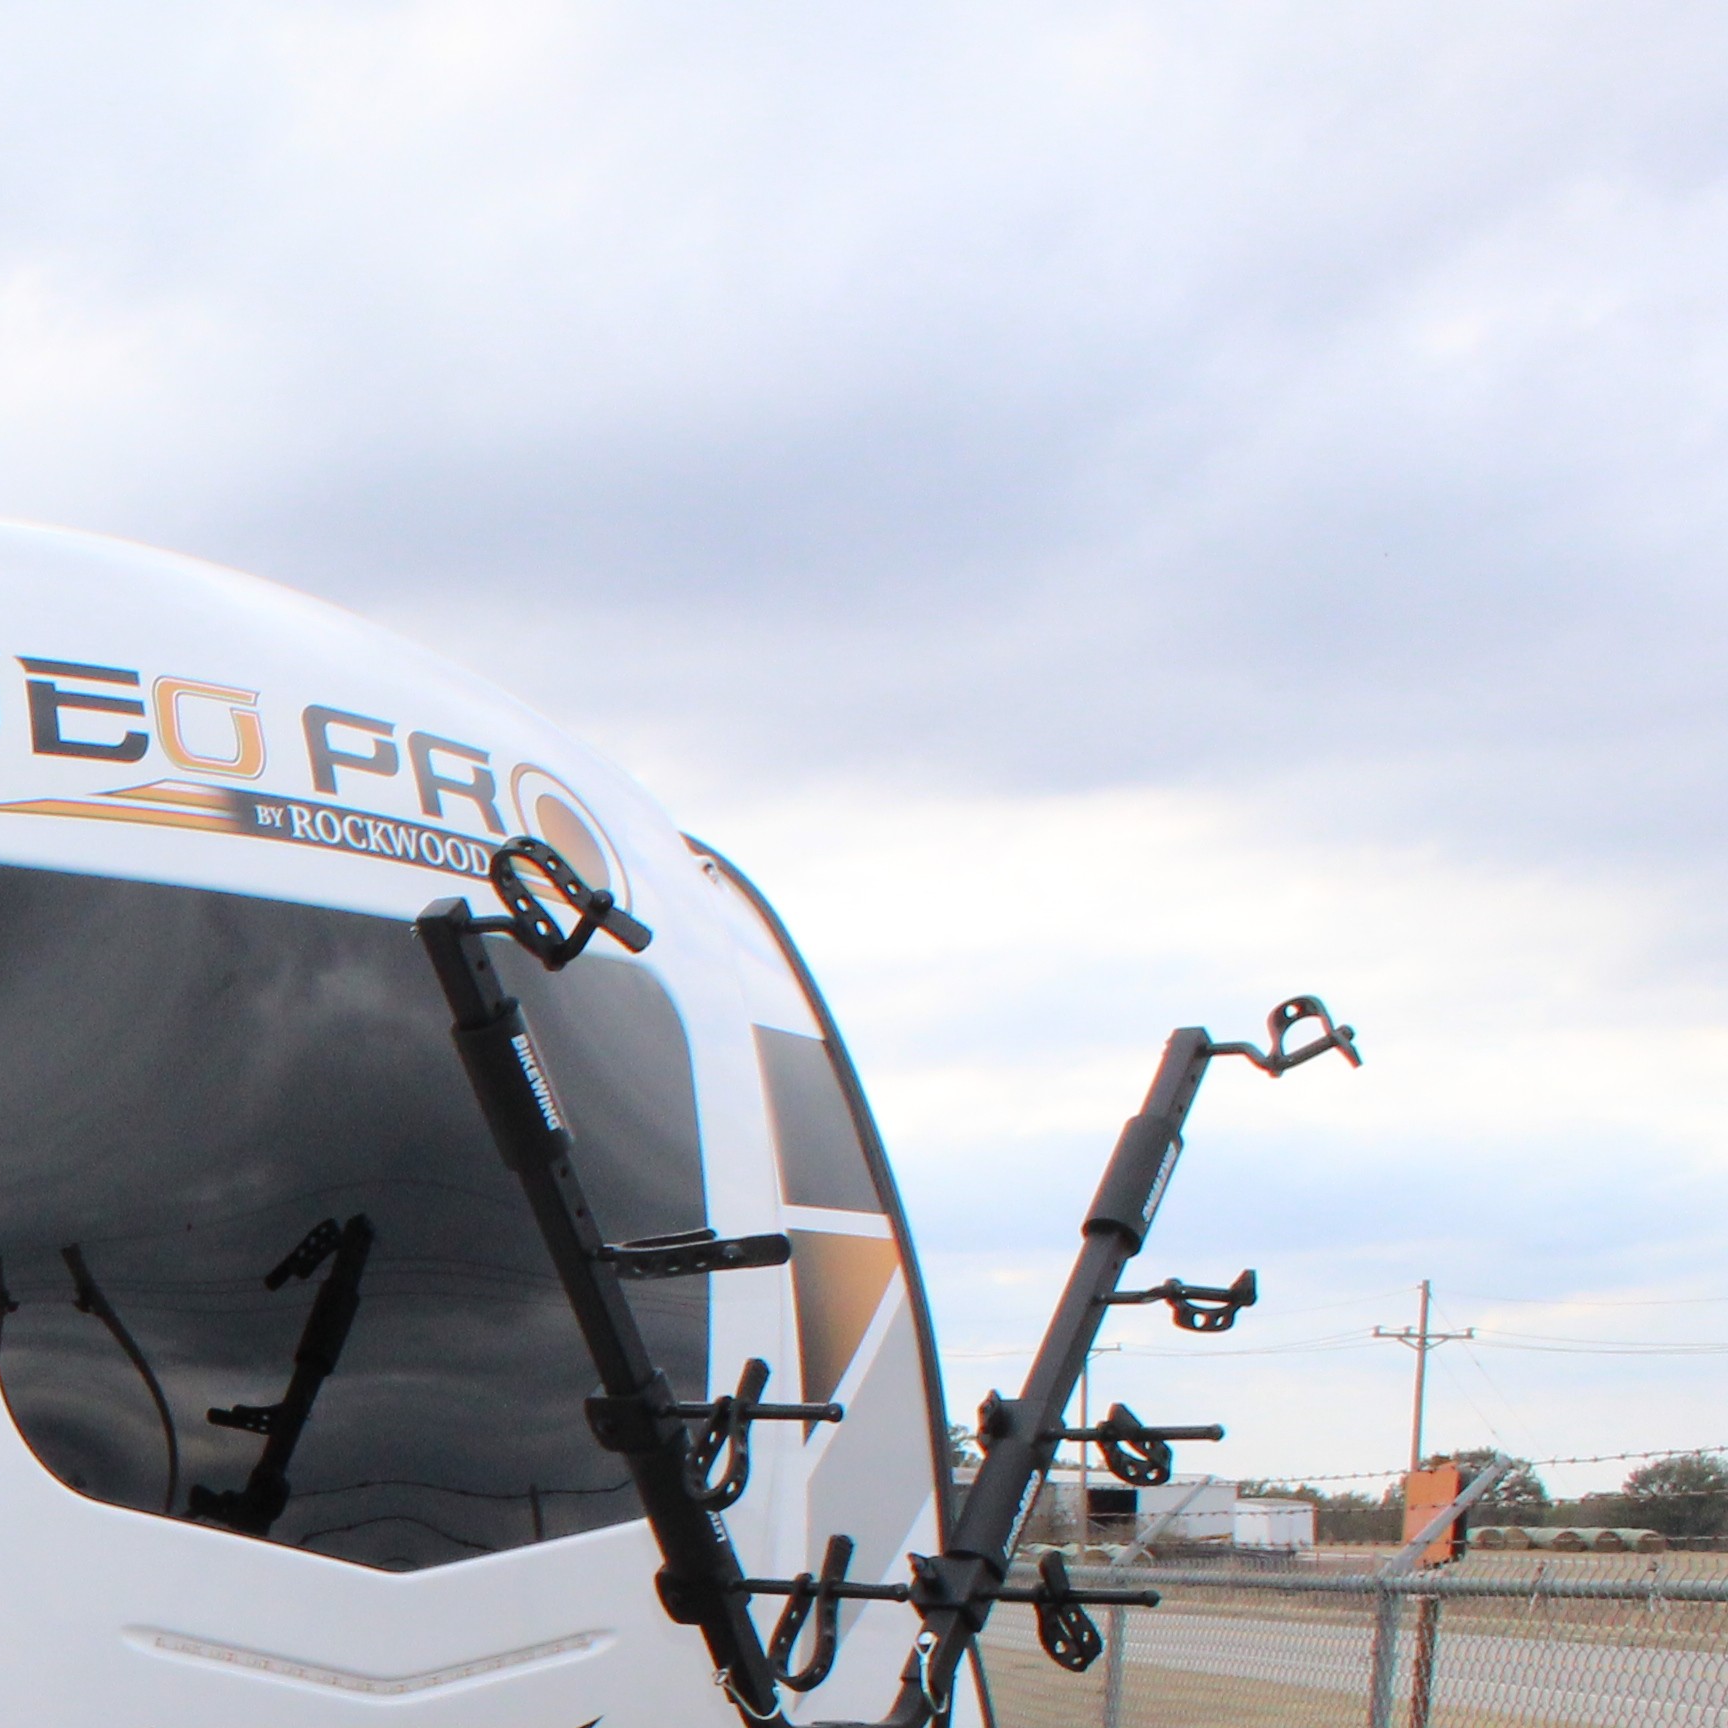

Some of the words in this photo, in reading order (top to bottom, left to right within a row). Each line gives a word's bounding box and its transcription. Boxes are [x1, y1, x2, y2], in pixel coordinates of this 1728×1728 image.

[255, 803, 284, 829] BY
[288, 806, 493, 880] ROCKWOOD
[511, 1033, 561, 1131] BIKEWING
